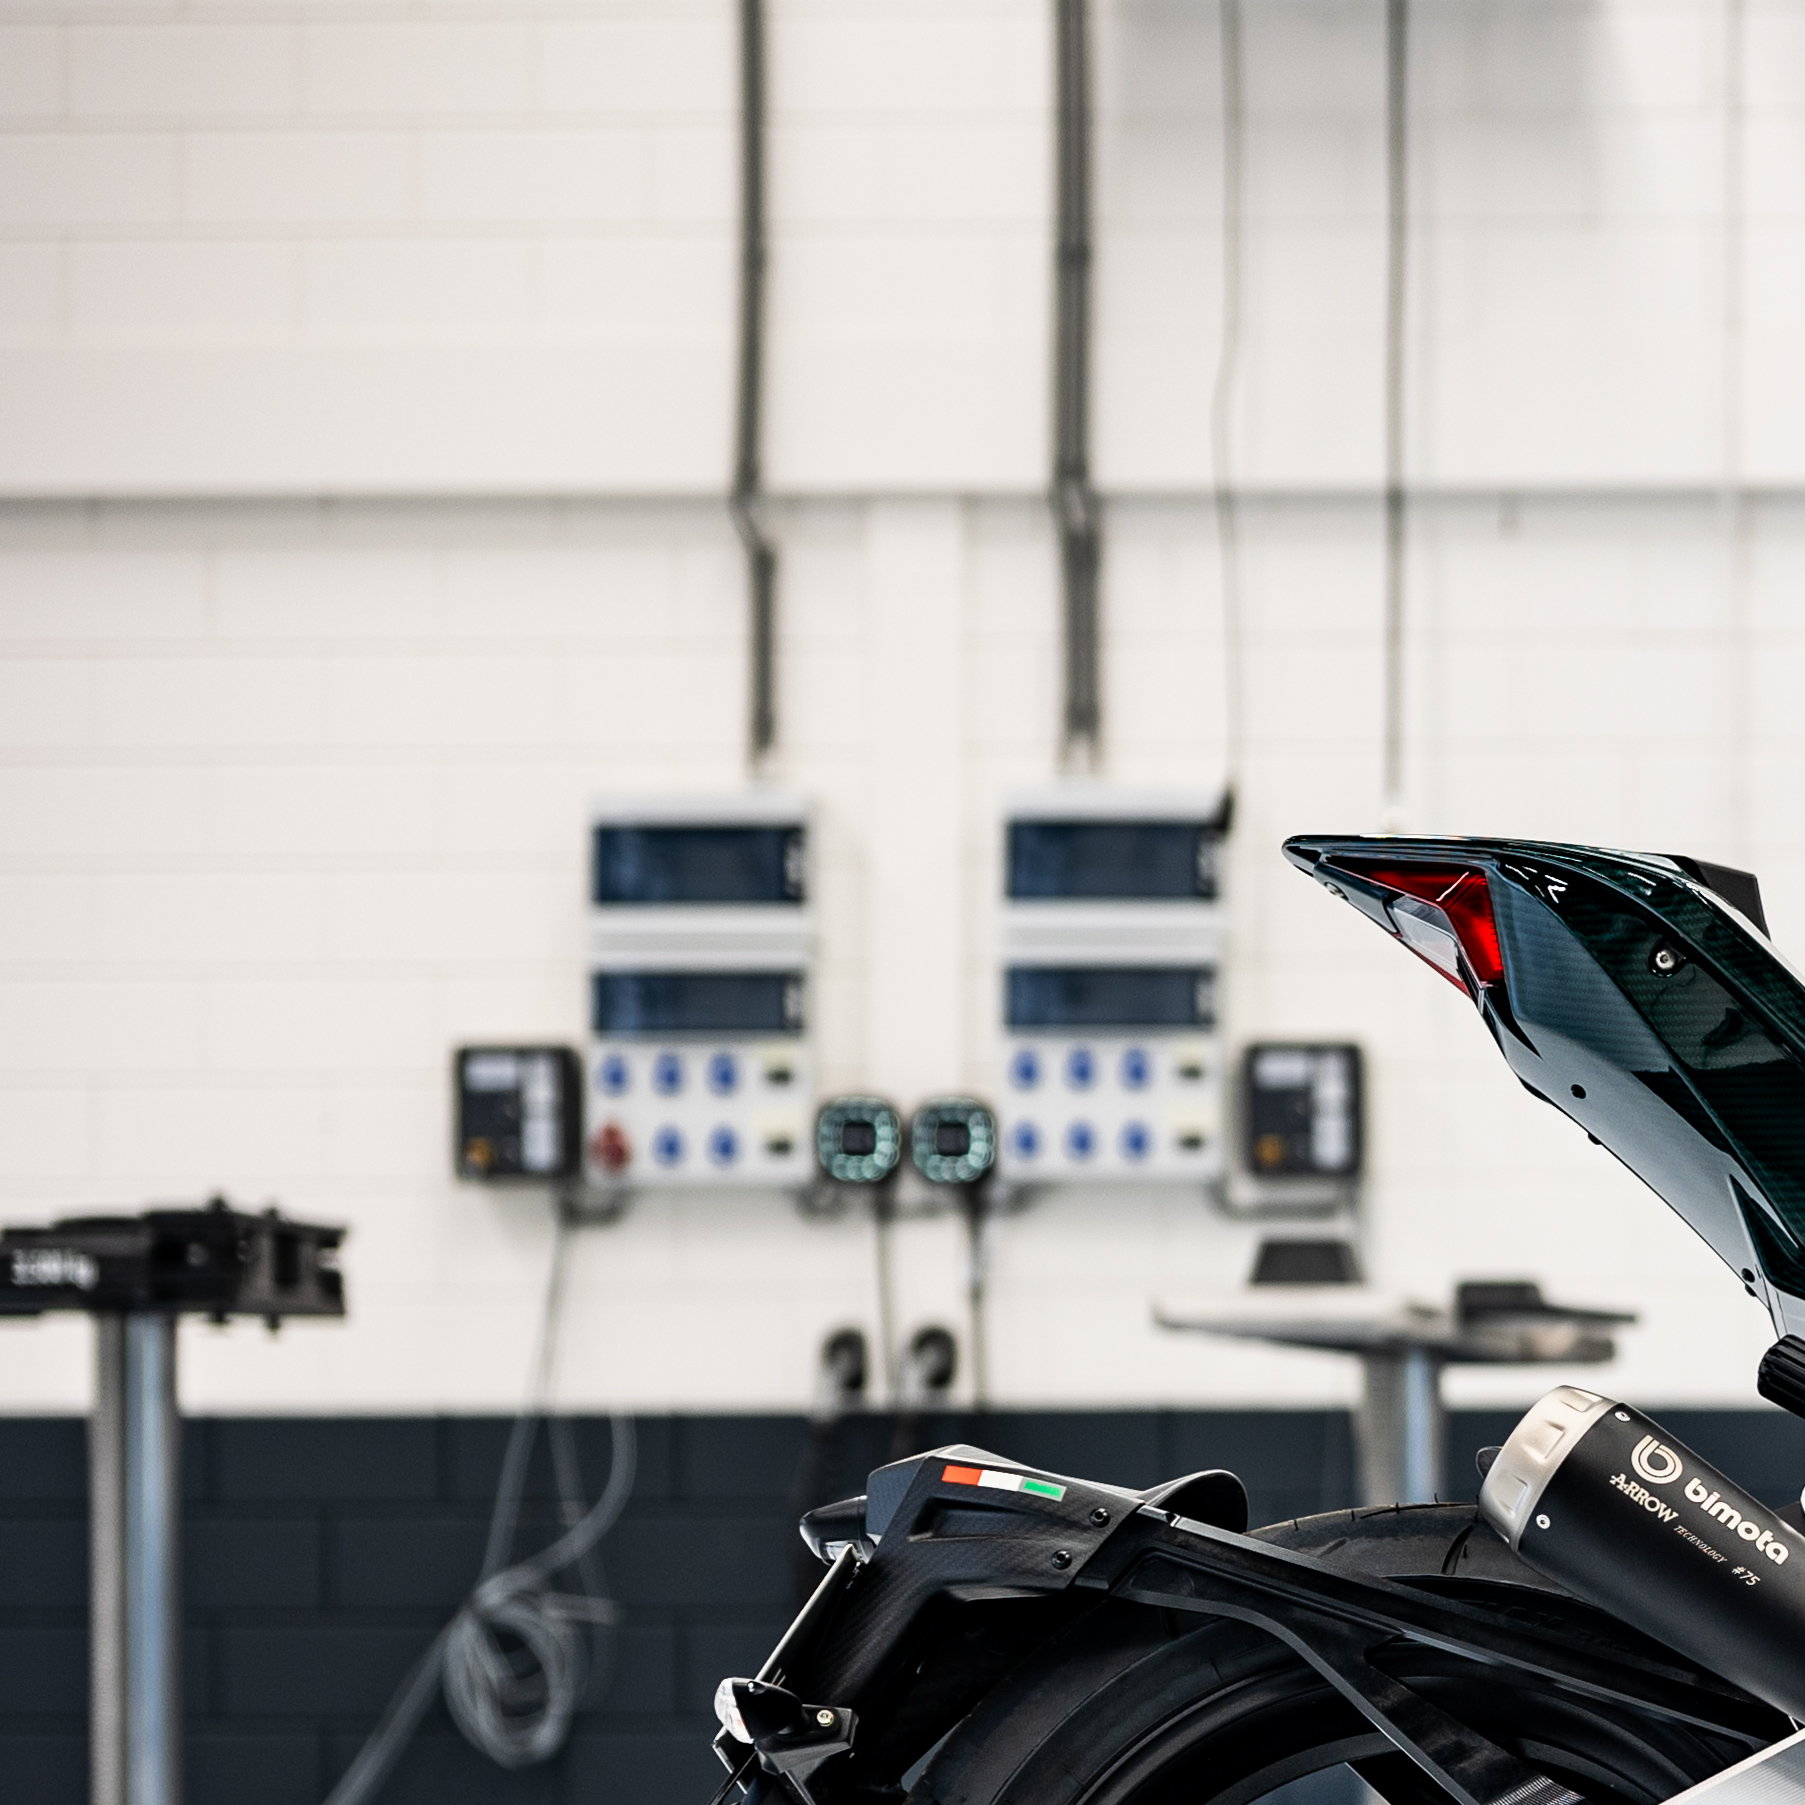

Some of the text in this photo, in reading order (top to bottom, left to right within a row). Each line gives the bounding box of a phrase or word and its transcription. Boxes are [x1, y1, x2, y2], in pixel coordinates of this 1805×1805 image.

[1609, 1473, 1761, 1586] ARROW TECHNOLOGY #75
[1684, 1477, 1790, 1565] bimota
